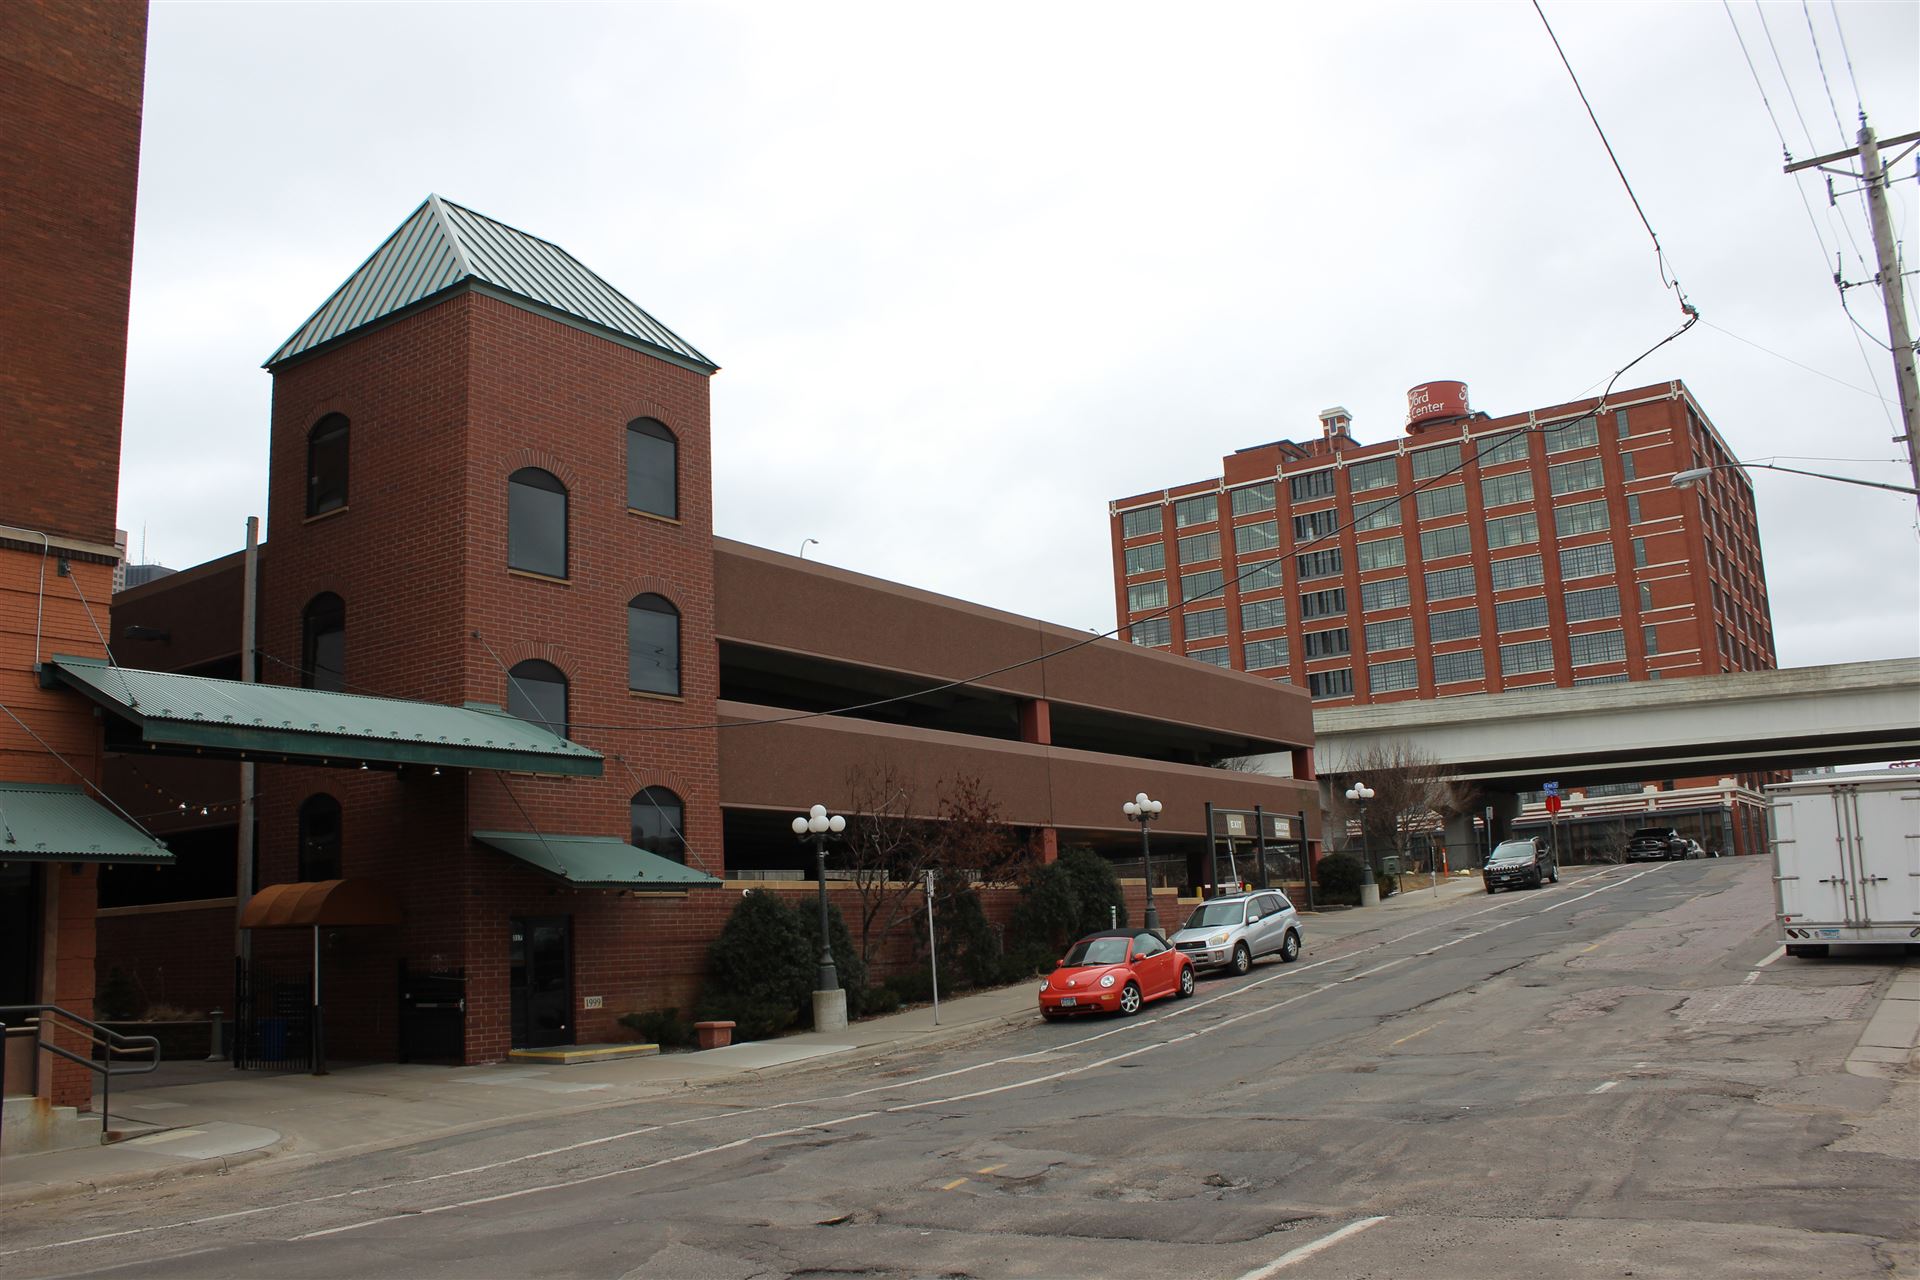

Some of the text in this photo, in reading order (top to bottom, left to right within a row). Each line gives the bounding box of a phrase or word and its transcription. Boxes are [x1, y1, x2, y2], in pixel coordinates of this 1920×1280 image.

[1408, 386, 1429, 410] Ford
[1411, 402, 1445, 419] Center
[1230, 820, 1242, 829] EXIT
[585, 998, 601, 1008] 1999
